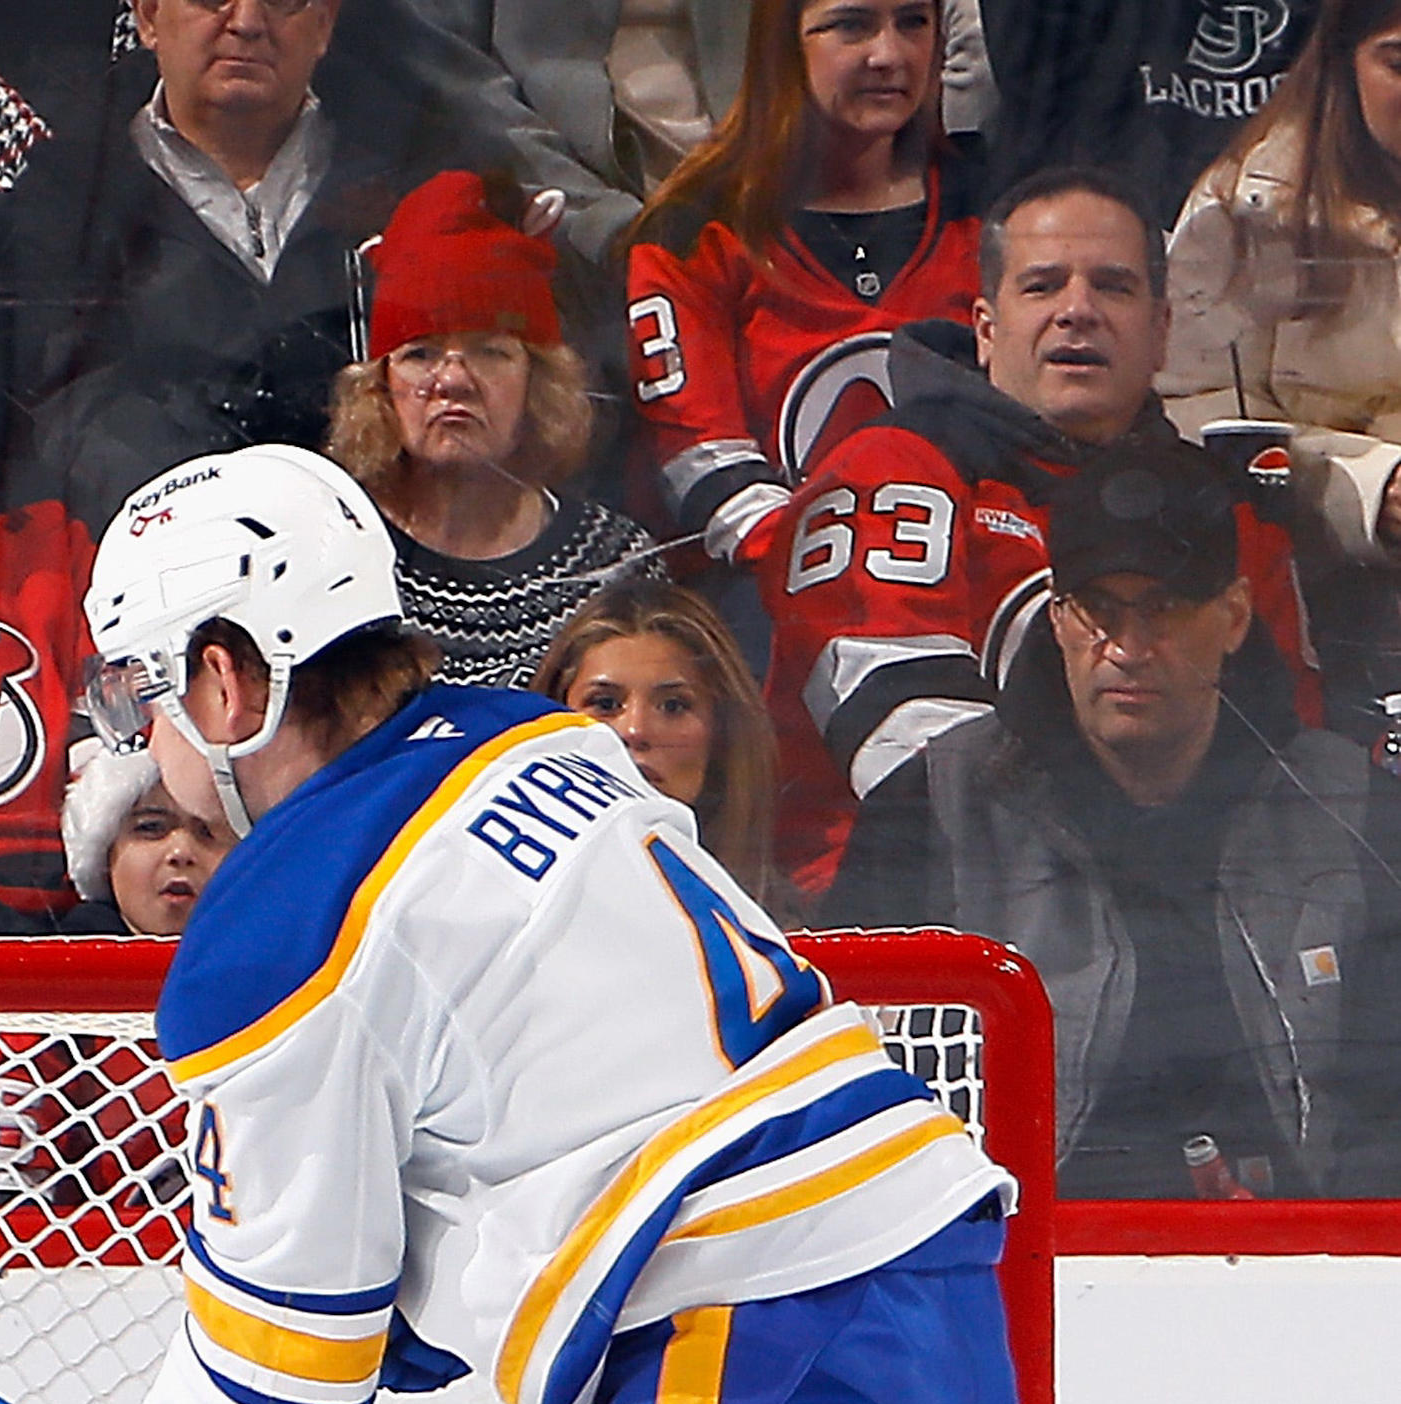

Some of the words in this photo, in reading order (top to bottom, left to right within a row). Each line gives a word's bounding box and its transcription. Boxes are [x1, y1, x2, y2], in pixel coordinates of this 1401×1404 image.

[128, 466, 222, 518] KeyBank
[785, 483, 956, 594] 63
[641, 830, 832, 1074] 4
[194, 1098, 238, 1227] 4
